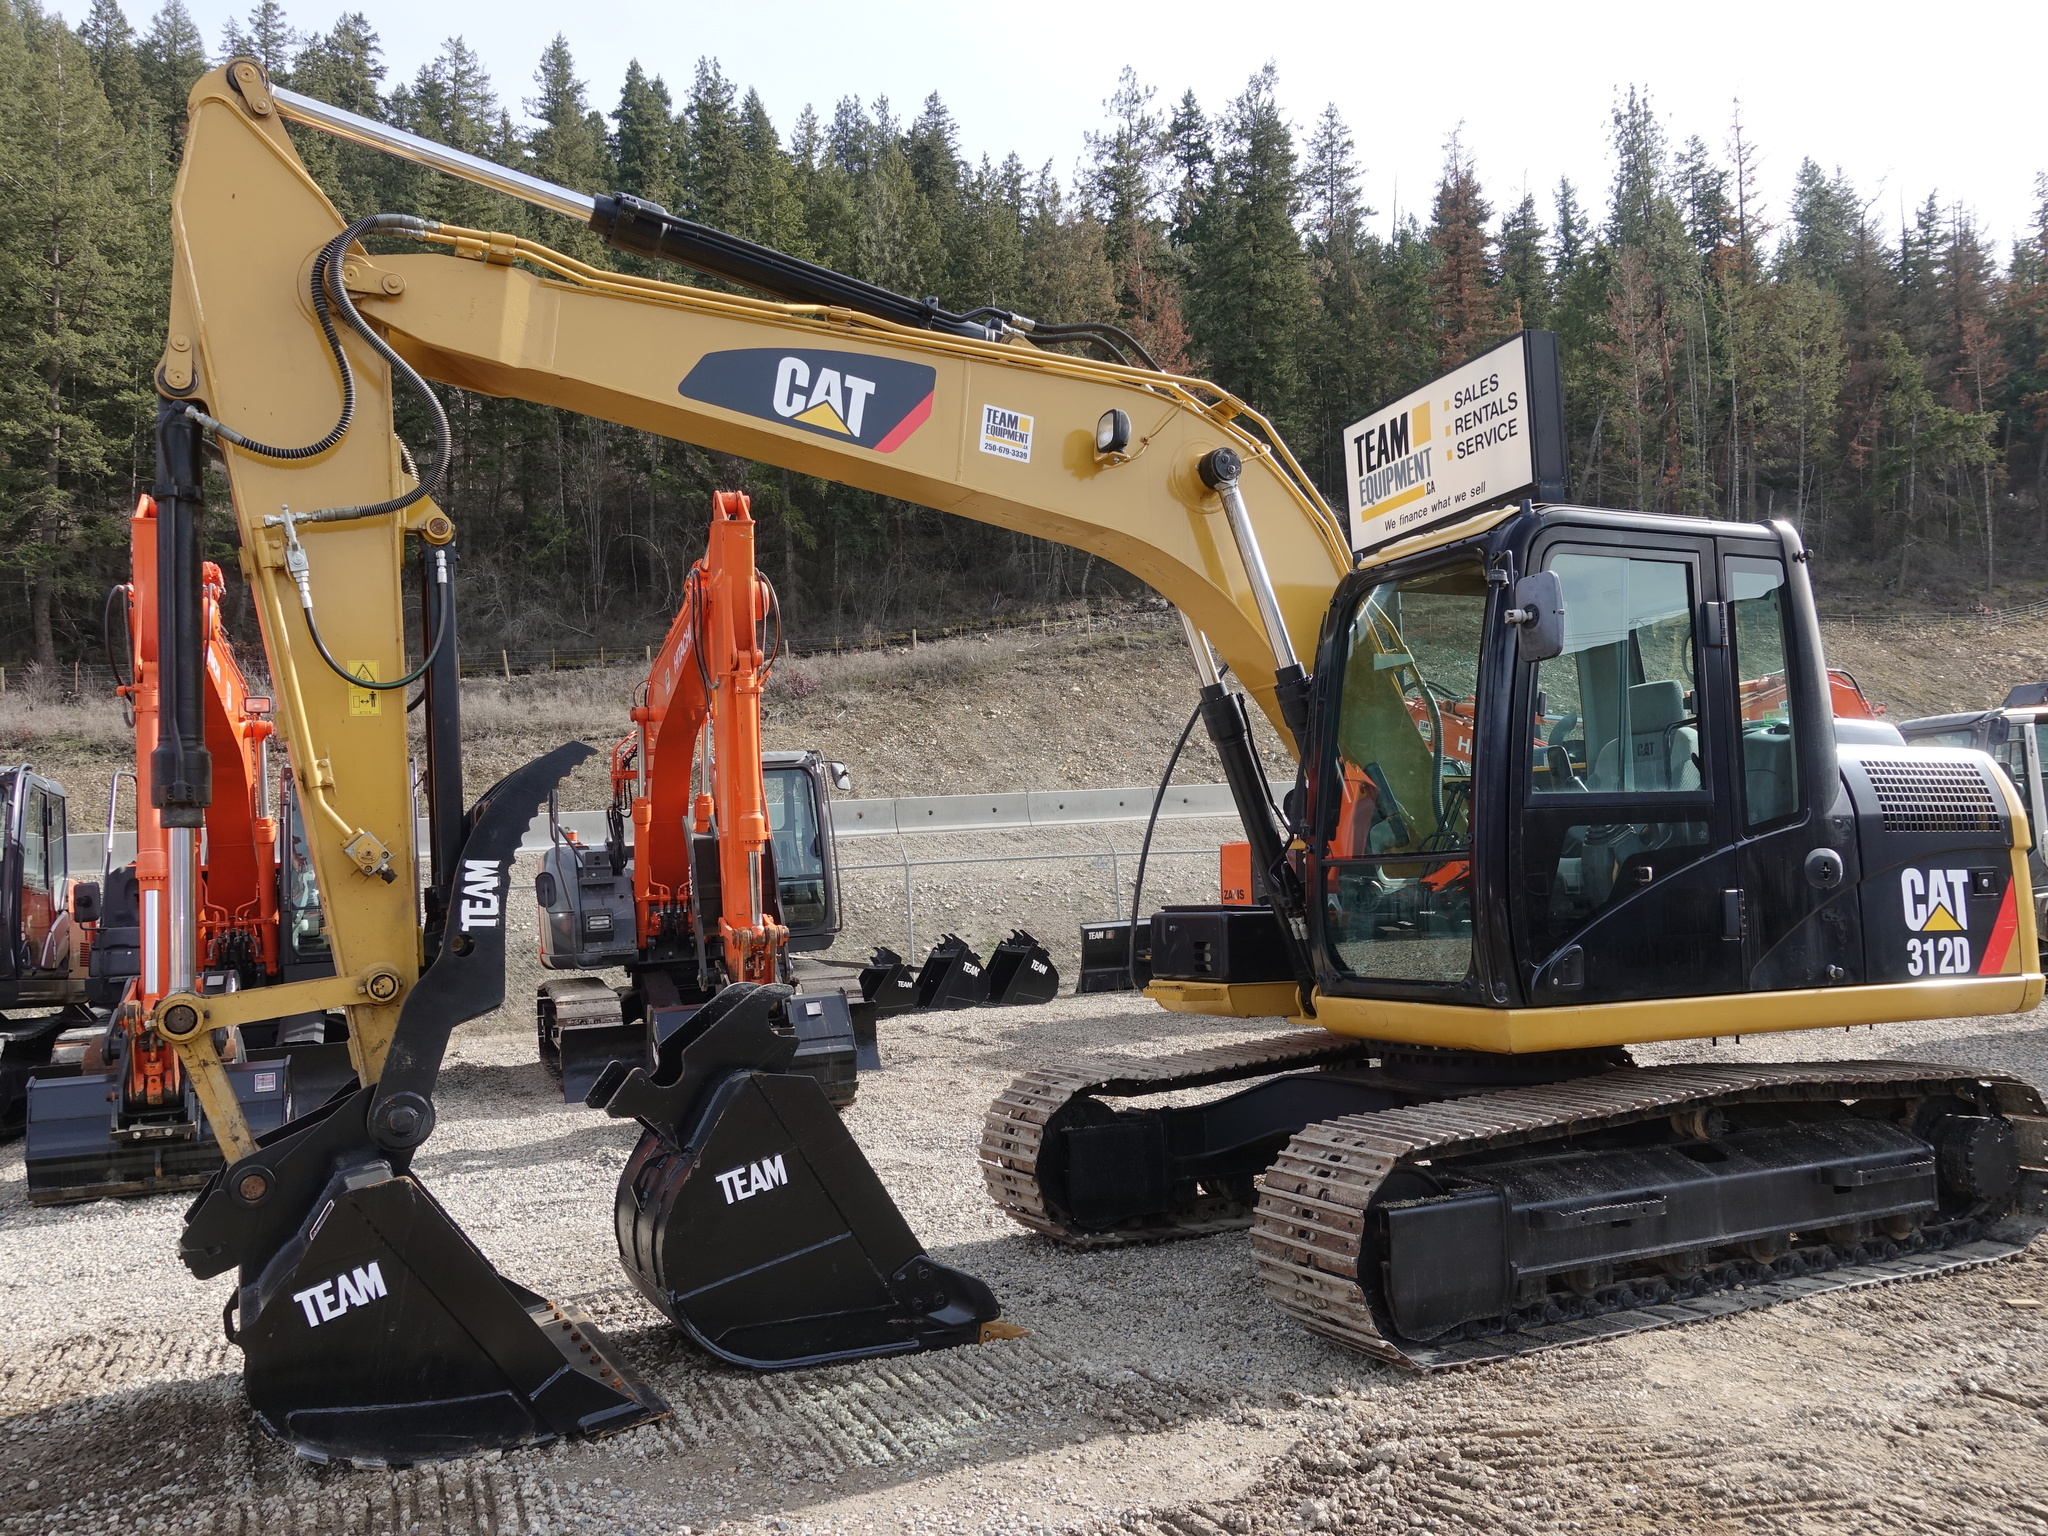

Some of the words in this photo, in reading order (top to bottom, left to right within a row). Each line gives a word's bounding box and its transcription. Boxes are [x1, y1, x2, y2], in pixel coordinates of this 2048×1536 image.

[773, 357, 876, 437] CAT
[1454, 373, 1499, 409] SALES
[986, 407, 1019, 431] TEAM
[986, 424, 1029, 444] EQUIPMENT
[1455, 391, 1518, 436] RENTALS
[984, 442, 1028, 460] 250-679-3339
[1354, 411, 1409, 478] TEAM
[1457, 418, 1518, 460] SERVICE
[1359, 447, 1432, 508] EQUIPMENT
[1385, 519, 1396, 532] We
[1399, 507, 1428, 527] finance
[1431, 496, 1451, 513] what
[1454, 491, 1467, 504] we
[1470, 481, 1486, 498] sell
[1637, 742, 1655, 757] CAT
[461, 860, 500, 932] TEAM
[1901, 867, 1969, 932] CAT
[1088, 931, 1104, 940] TEAM
[1906, 936, 1971, 976] 312D
[897, 980, 913, 988] TEAM
[963, 962, 981, 977] TEAM
[1031, 959, 1048, 975] TEAM
[715, 1154, 788, 1205] TEAM
[292, 1261, 388, 1328] TEAM
